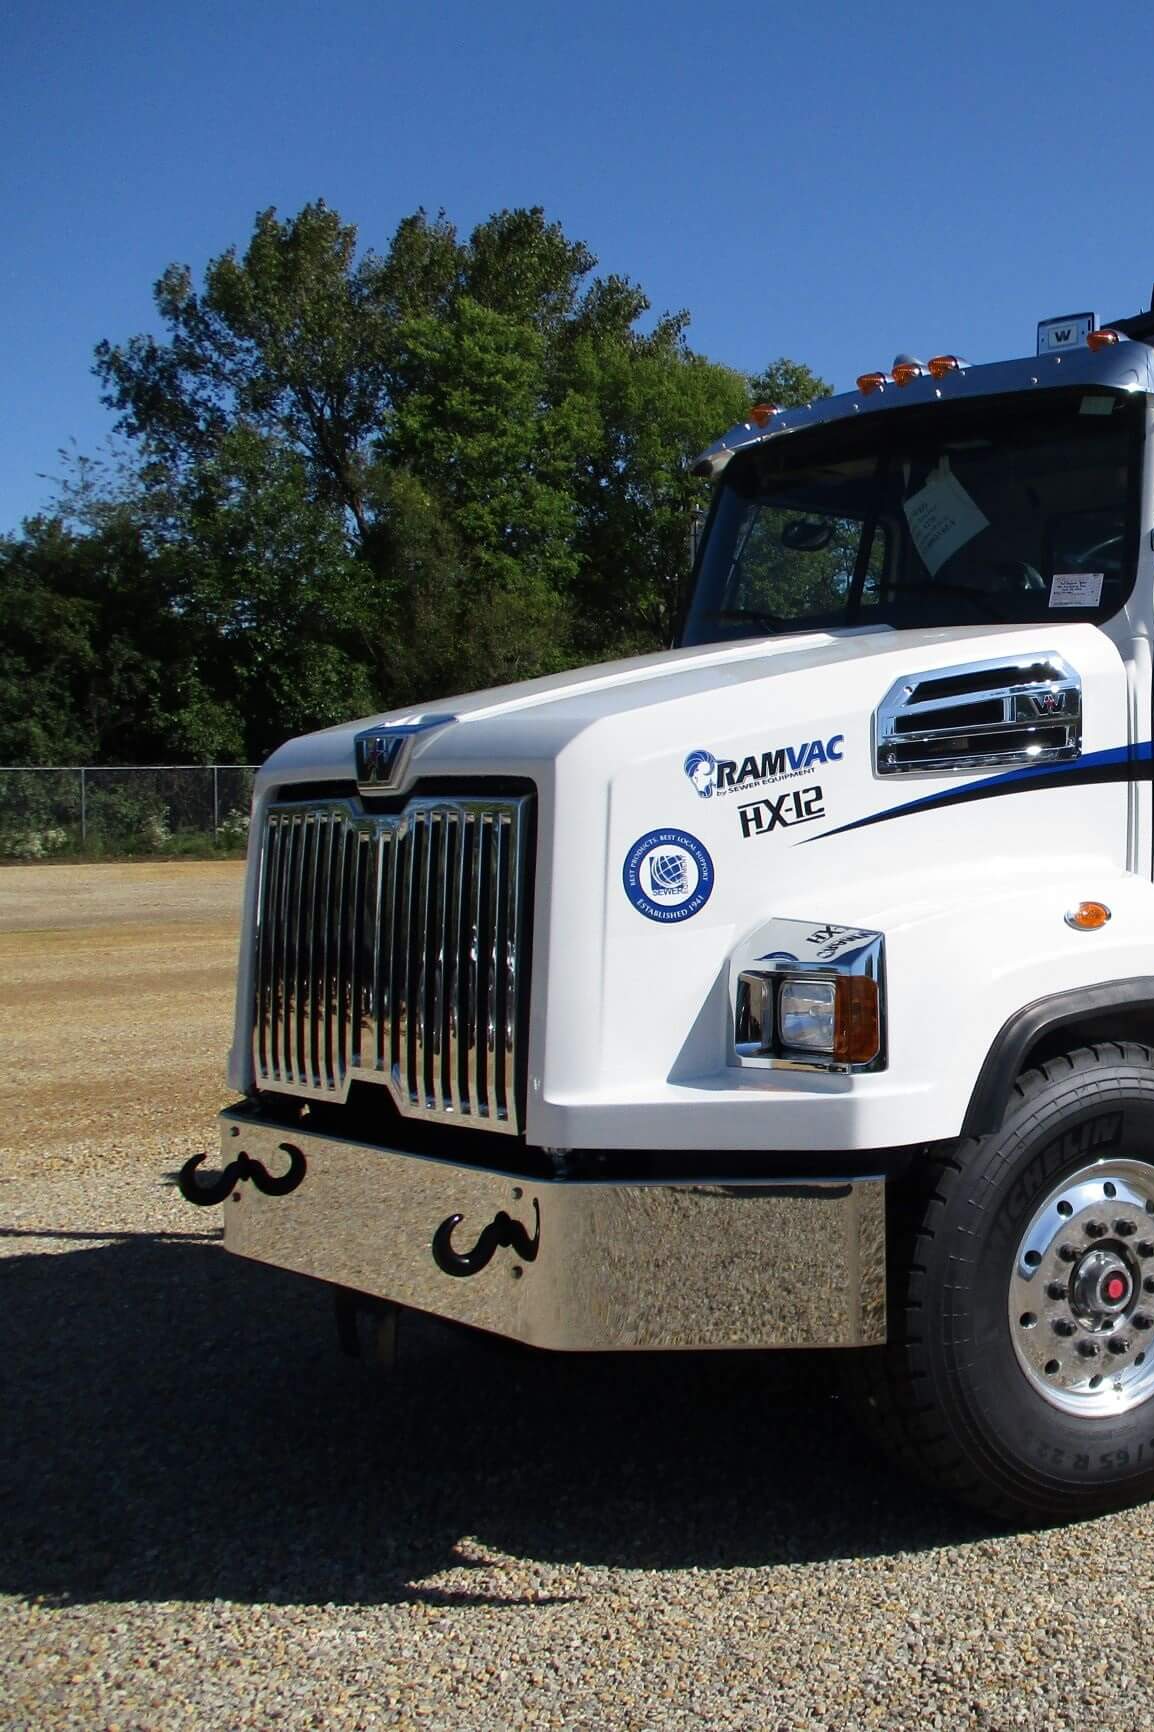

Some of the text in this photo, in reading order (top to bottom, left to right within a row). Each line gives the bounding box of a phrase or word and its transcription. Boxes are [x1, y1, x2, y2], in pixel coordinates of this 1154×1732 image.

[1055, 330, 1072, 342] W
[716, 735, 845, 789] RAMVAC
[716, 766, 816, 797] by SEWER EQUIPMENT
[737, 786, 826, 838] HX-12
[629, 870, 637, 886] BEST
[677, 835, 697, 851] LOCAL
[695, 850, 709, 881] SUPPORT
[652, 888, 683, 896] SEWER
[637, 898, 688, 919] ESTABLISHED
